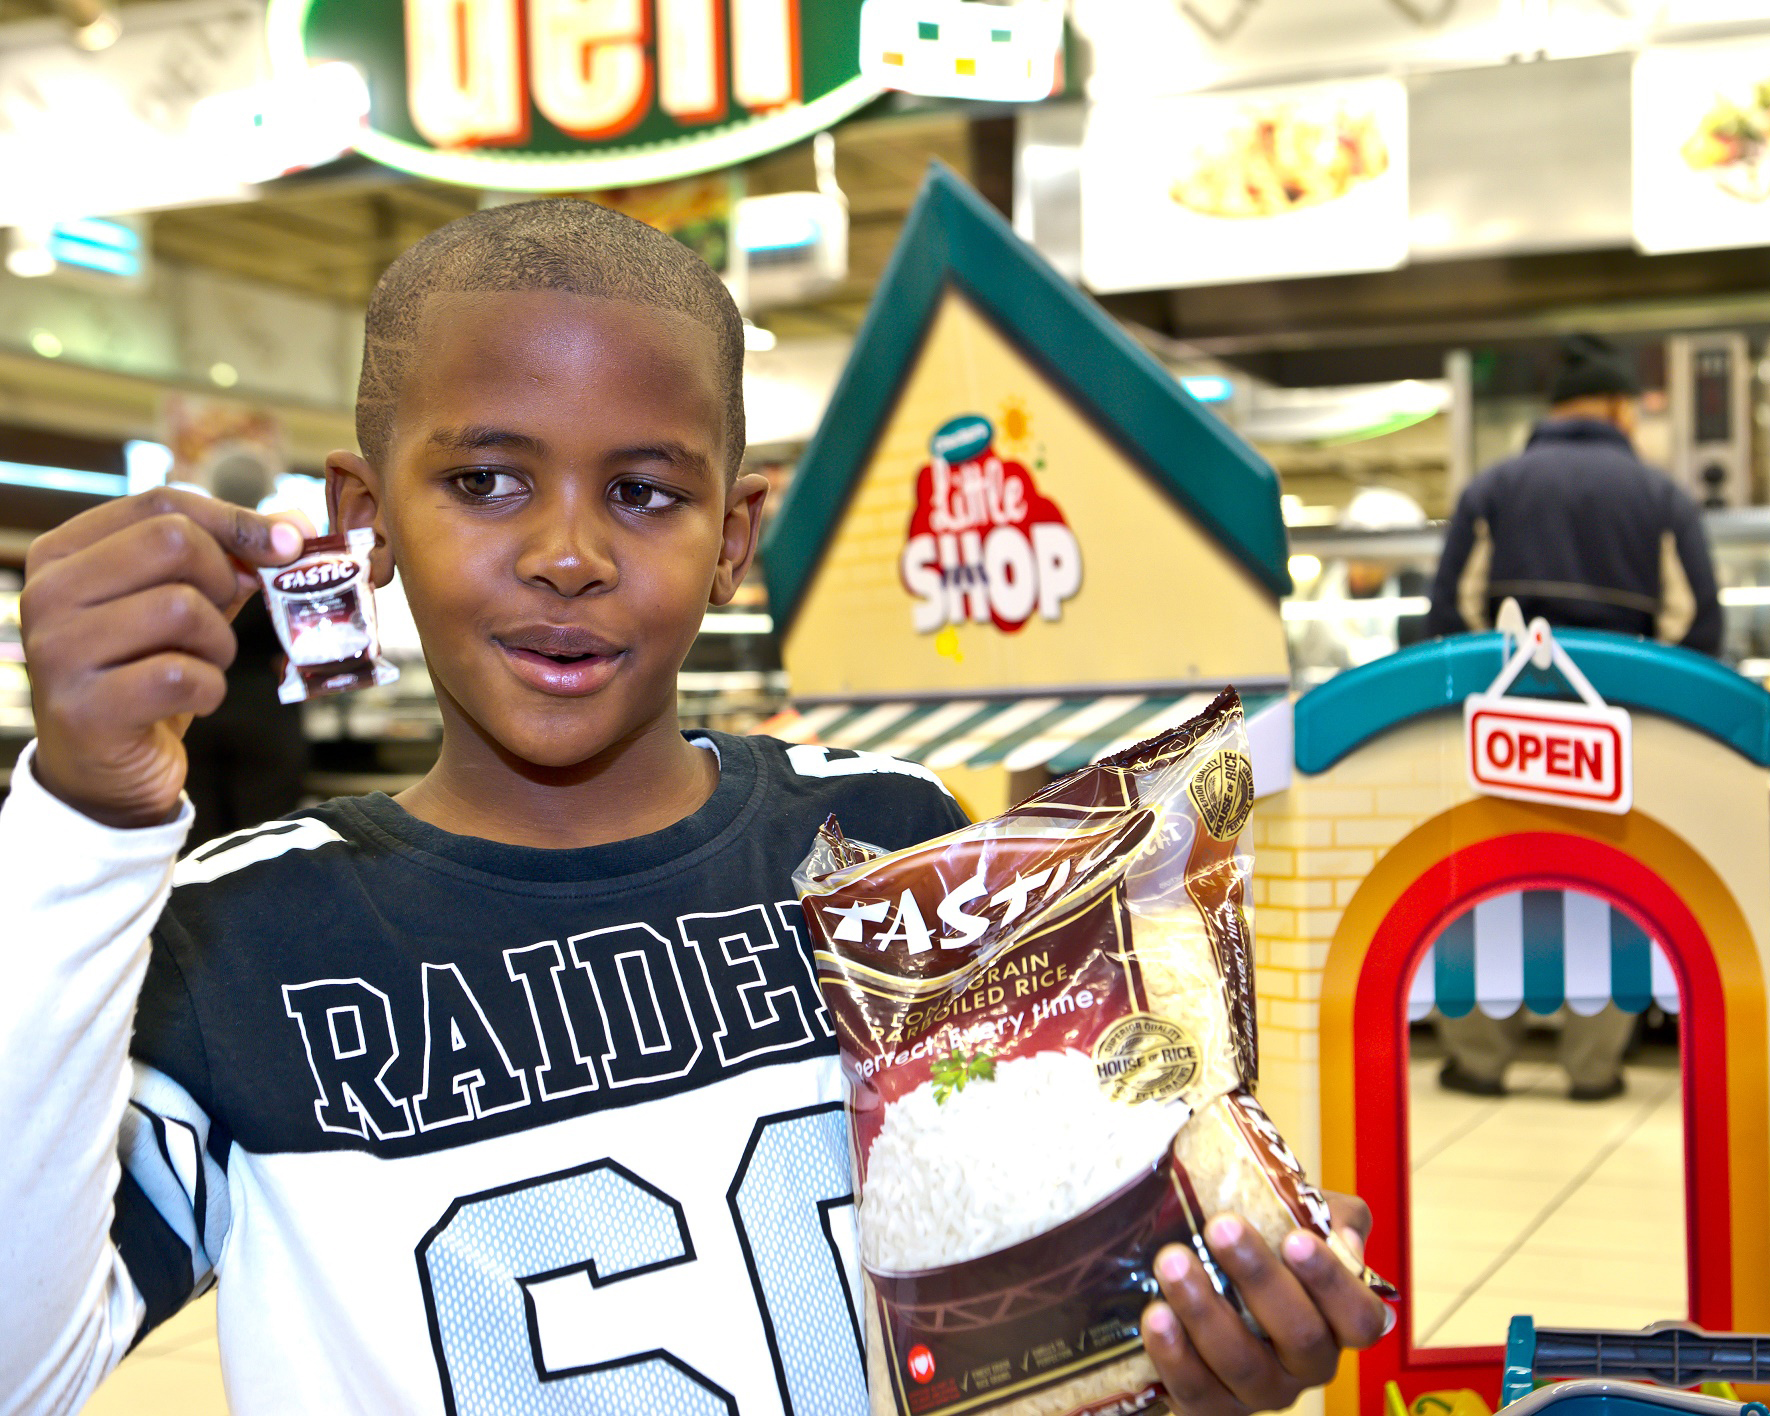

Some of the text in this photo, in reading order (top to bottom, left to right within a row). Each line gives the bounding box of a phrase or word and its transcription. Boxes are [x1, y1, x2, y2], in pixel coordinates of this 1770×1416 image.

[279, 561, 355, 591] TASTIC
[902, 523, 1082, 633] SHOP
[1195, 758, 1218, 783] QUALITY
[1486, 730, 1604, 783] OPEN
[1213, 793, 1233, 839] HOUSE
[1224, 752, 1237, 782] RICE
[968, 951, 1050, 991] GRAIN
[1032, 989, 1104, 1022] time.
[1096, 1055, 1146, 1079] HOUSE
[1161, 1045, 1197, 1064] RICE
